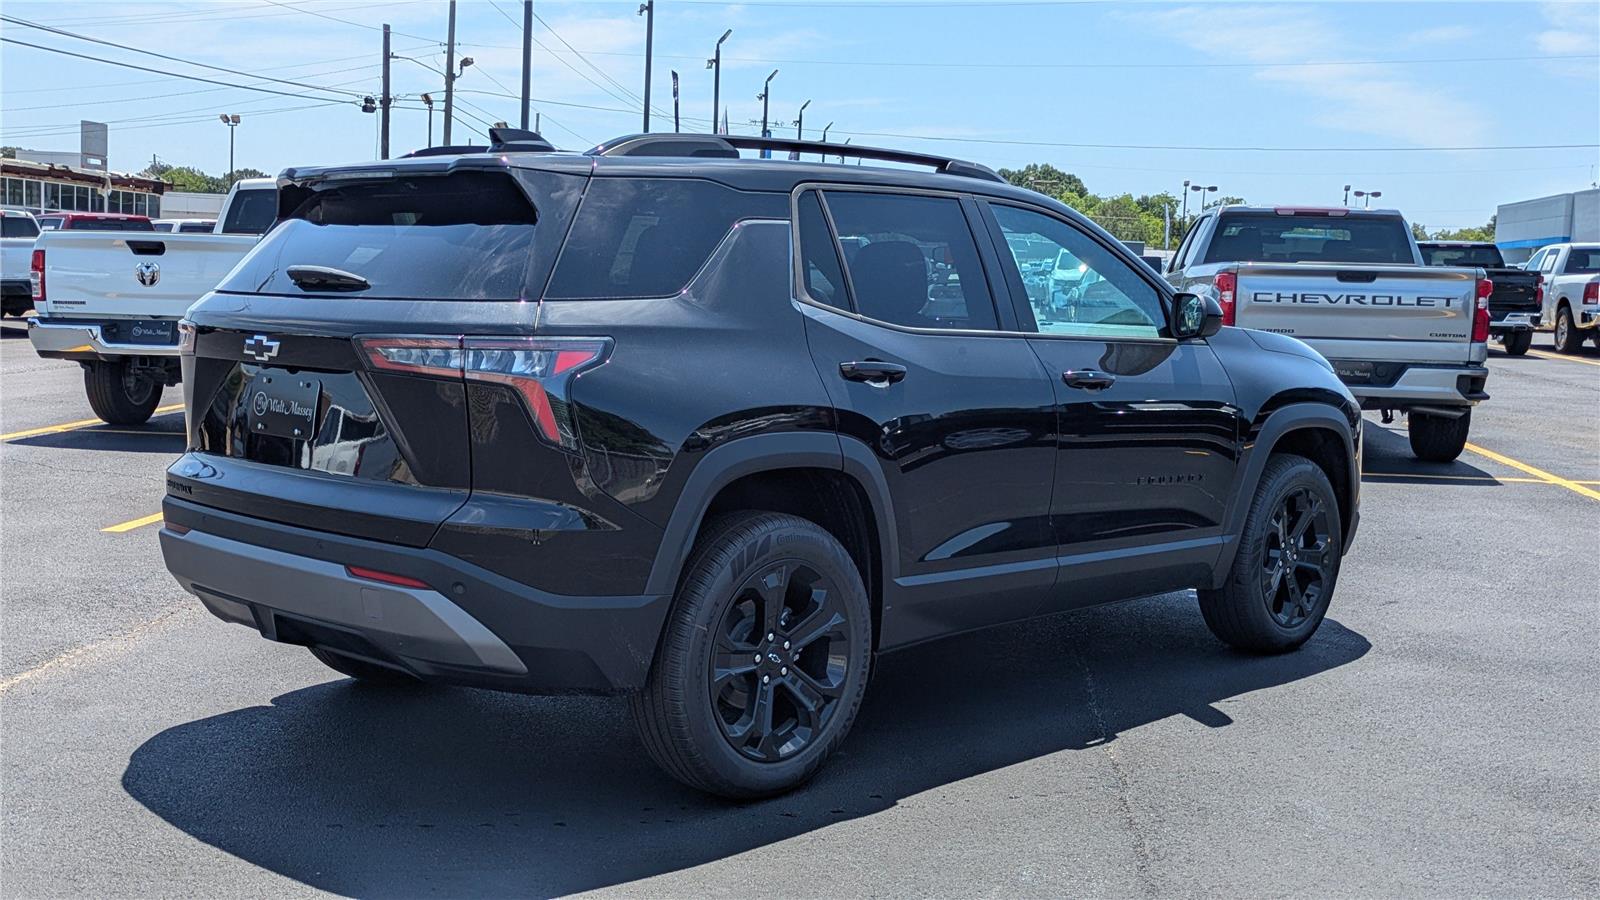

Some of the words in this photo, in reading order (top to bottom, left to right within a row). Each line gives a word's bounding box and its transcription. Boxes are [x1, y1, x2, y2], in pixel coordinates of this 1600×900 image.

[1253, 292, 1458, 308] CHEVROLET
[268, 398, 285, 413] Walt
[284, 400, 313, 422] Massey
